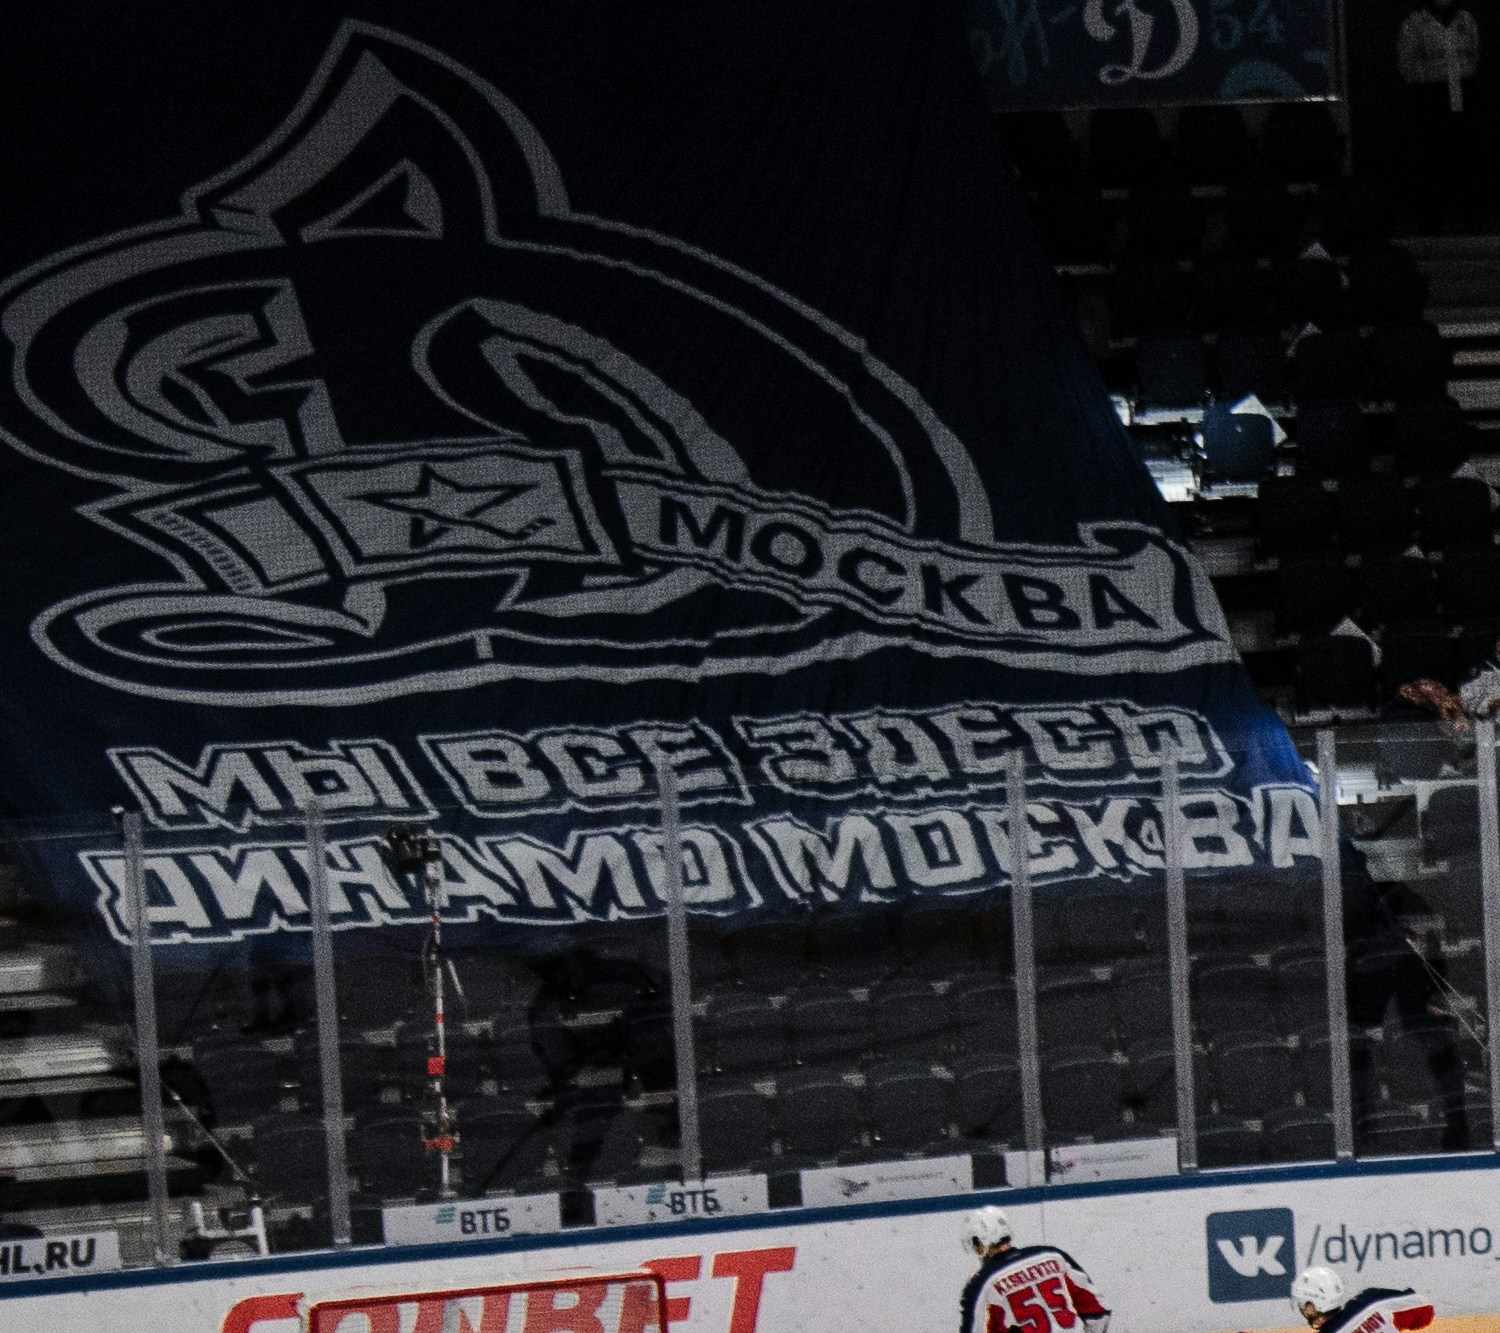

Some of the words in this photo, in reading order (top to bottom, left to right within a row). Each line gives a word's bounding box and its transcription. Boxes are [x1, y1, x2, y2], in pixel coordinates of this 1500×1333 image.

[657, 491, 1156, 636] МОСКВА
[121, 743, 415, 824] МЫ
[434, 724, 725, 806] ВСЕ
[752, 706, 1213, 793] ЗДЕСЬ
[107, 828, 735, 934] ДИНАМО
[777, 790, 1330, 897] МОСКВА
[459, 1208, 511, 1236] ВТБ
